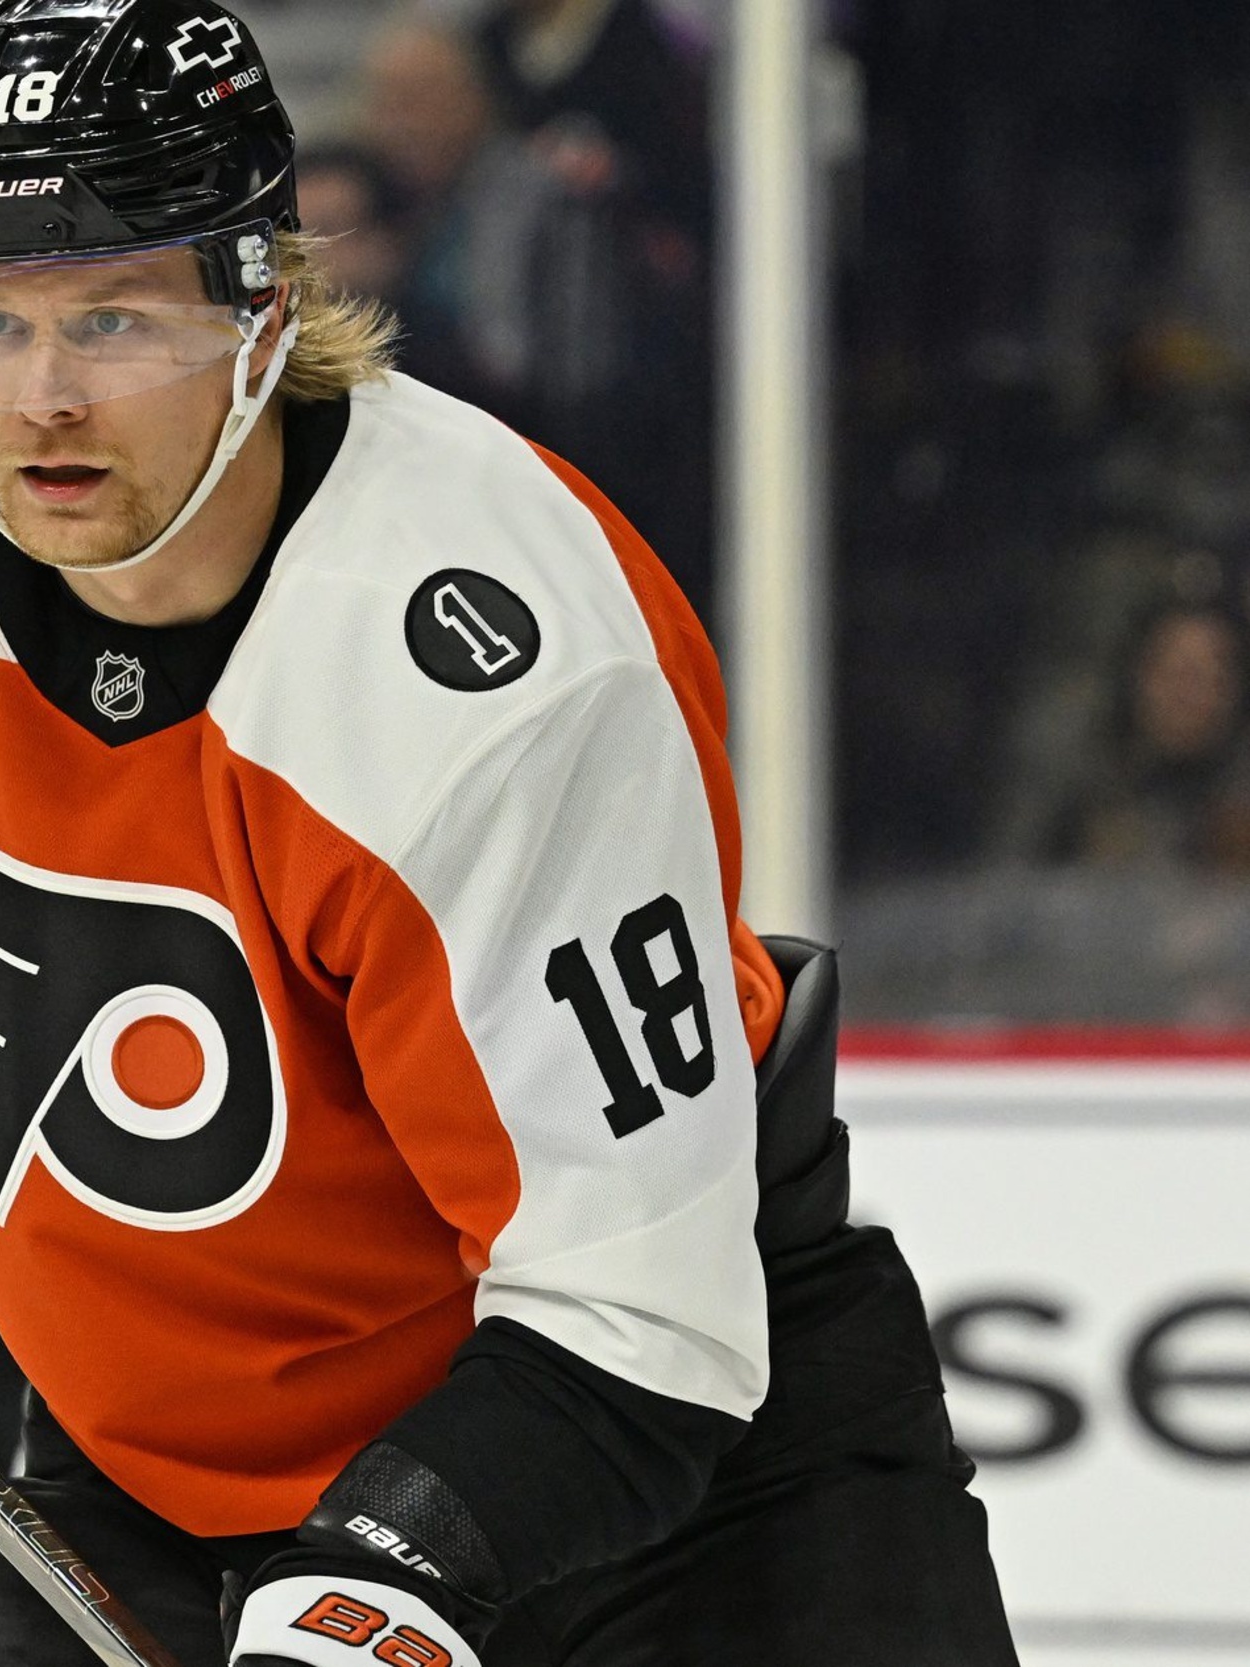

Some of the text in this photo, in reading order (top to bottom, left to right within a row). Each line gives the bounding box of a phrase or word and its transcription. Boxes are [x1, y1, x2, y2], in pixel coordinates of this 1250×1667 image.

[434, 583, 520, 675] 1
[103, 673, 134, 703] NHL
[544, 893, 716, 1140] 18
